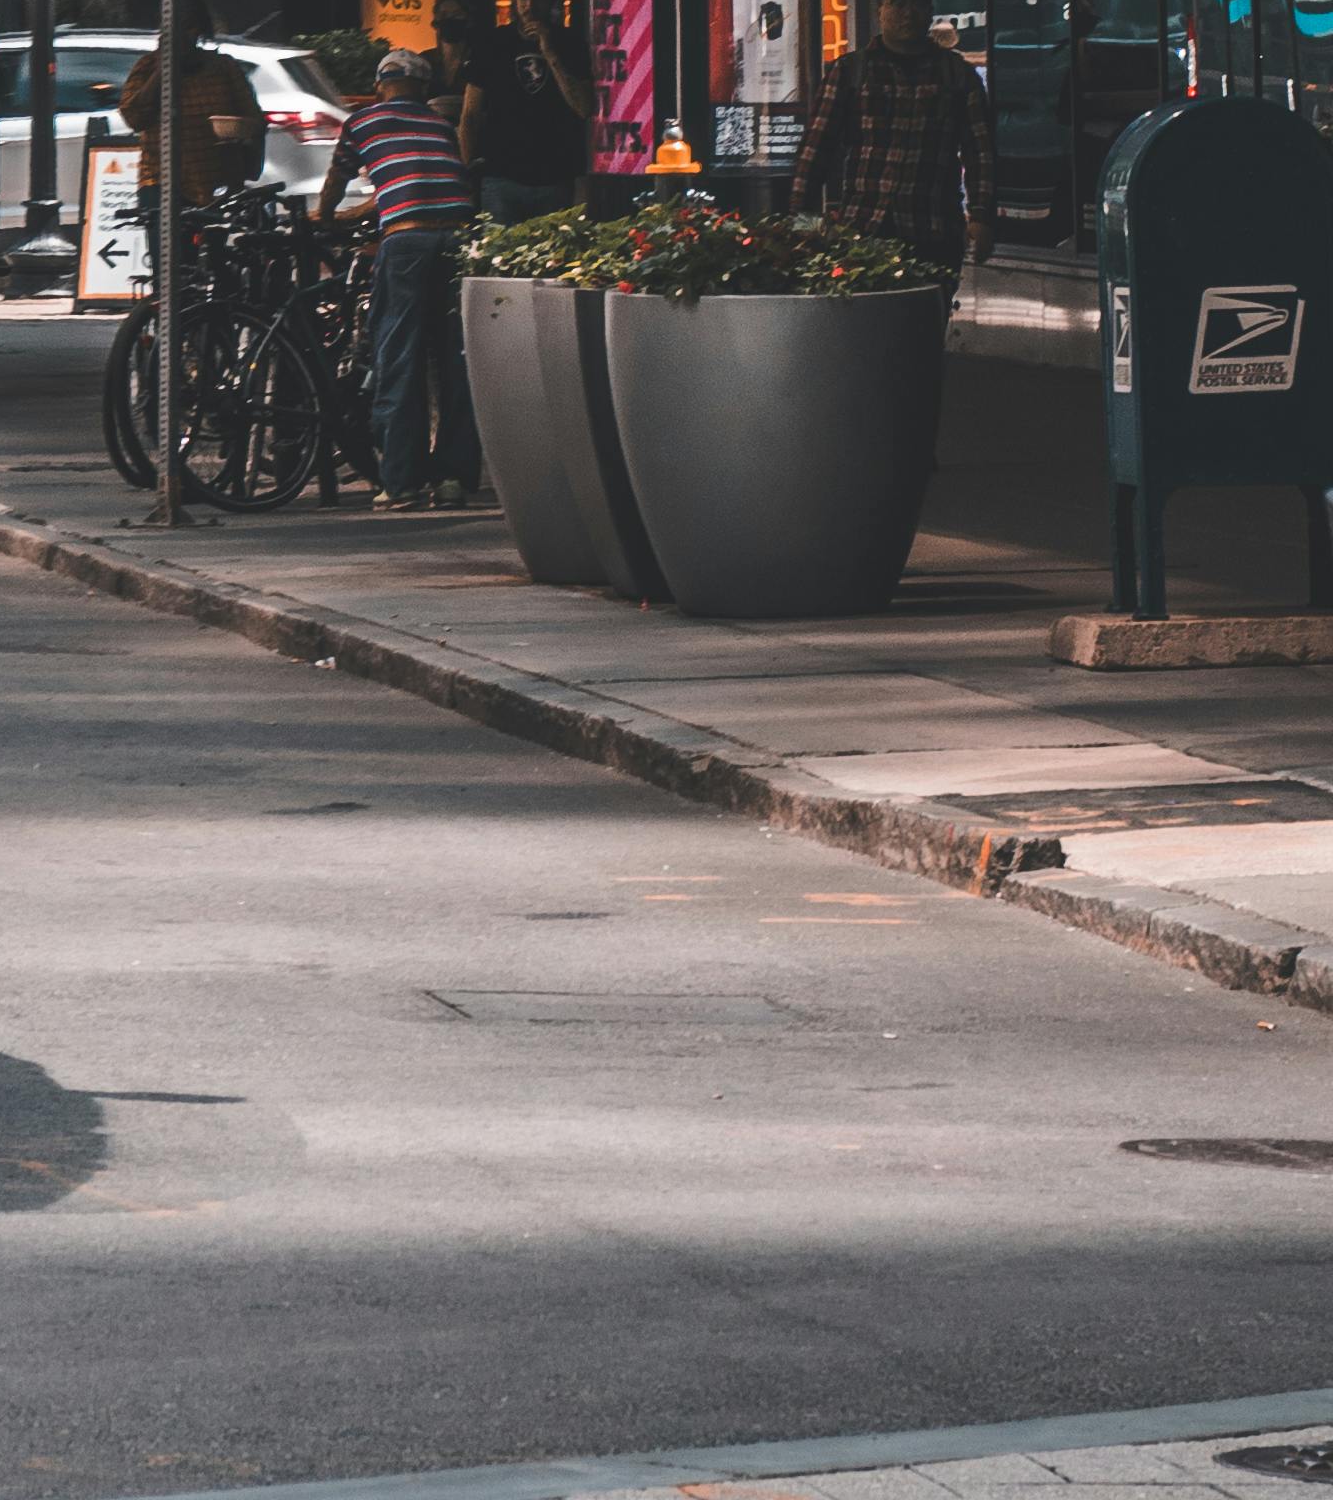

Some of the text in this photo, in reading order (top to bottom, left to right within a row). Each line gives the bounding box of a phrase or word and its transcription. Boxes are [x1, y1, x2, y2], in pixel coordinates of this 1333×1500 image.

[1198, 361, 1285, 376] UNITED STATES
[1196, 373, 1287, 388] POSTAL SERVICE
